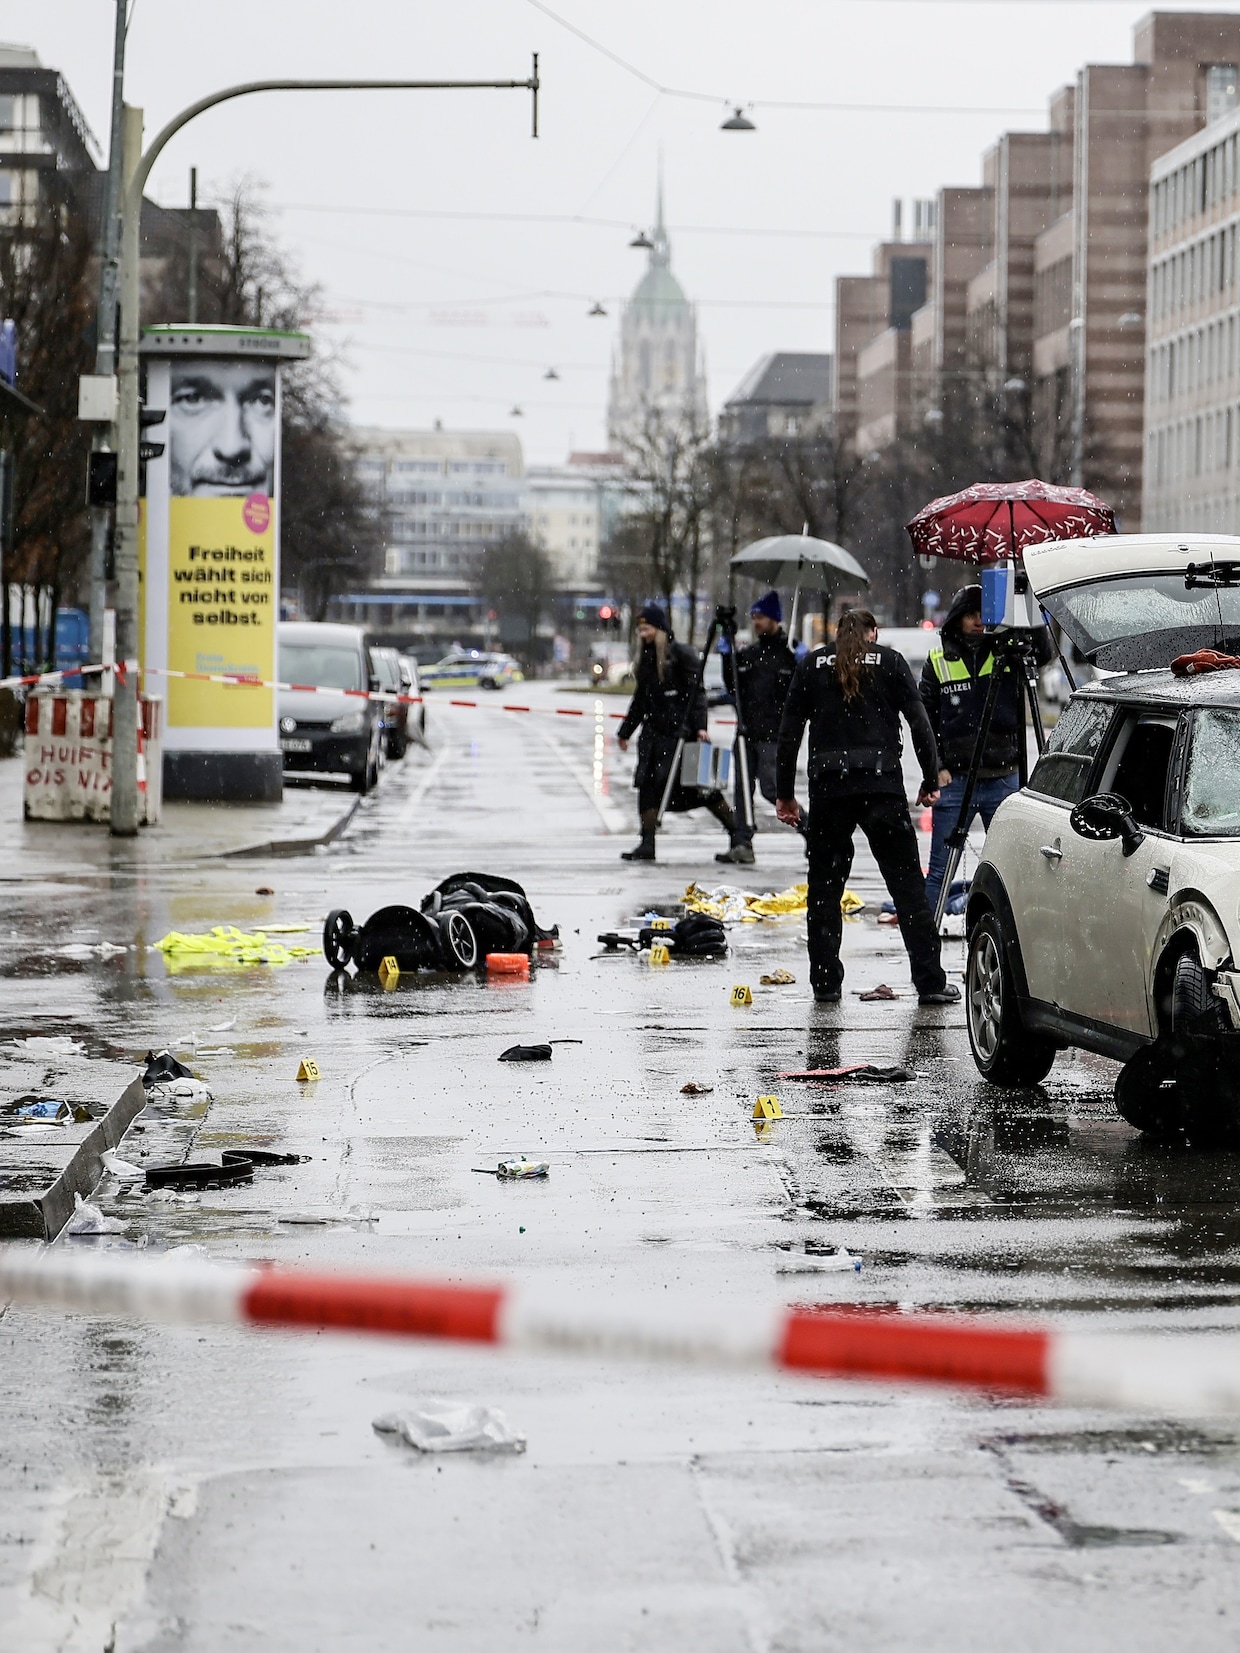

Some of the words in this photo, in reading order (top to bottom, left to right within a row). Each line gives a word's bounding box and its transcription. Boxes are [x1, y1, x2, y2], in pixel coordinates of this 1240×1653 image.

[188, 546, 265, 561] Freiheit
[174, 566, 236, 582] wählt
[241, 569, 272, 583] sich
[179, 587, 236, 603] nicht
[242, 592, 268, 603] von
[193, 609, 261, 625] selbst.
[653, 949, 662, 959] 11
[733, 987, 745, 1000] 16
[306, 1061, 318, 1076] 15
[766, 1099, 775, 1114] 1
